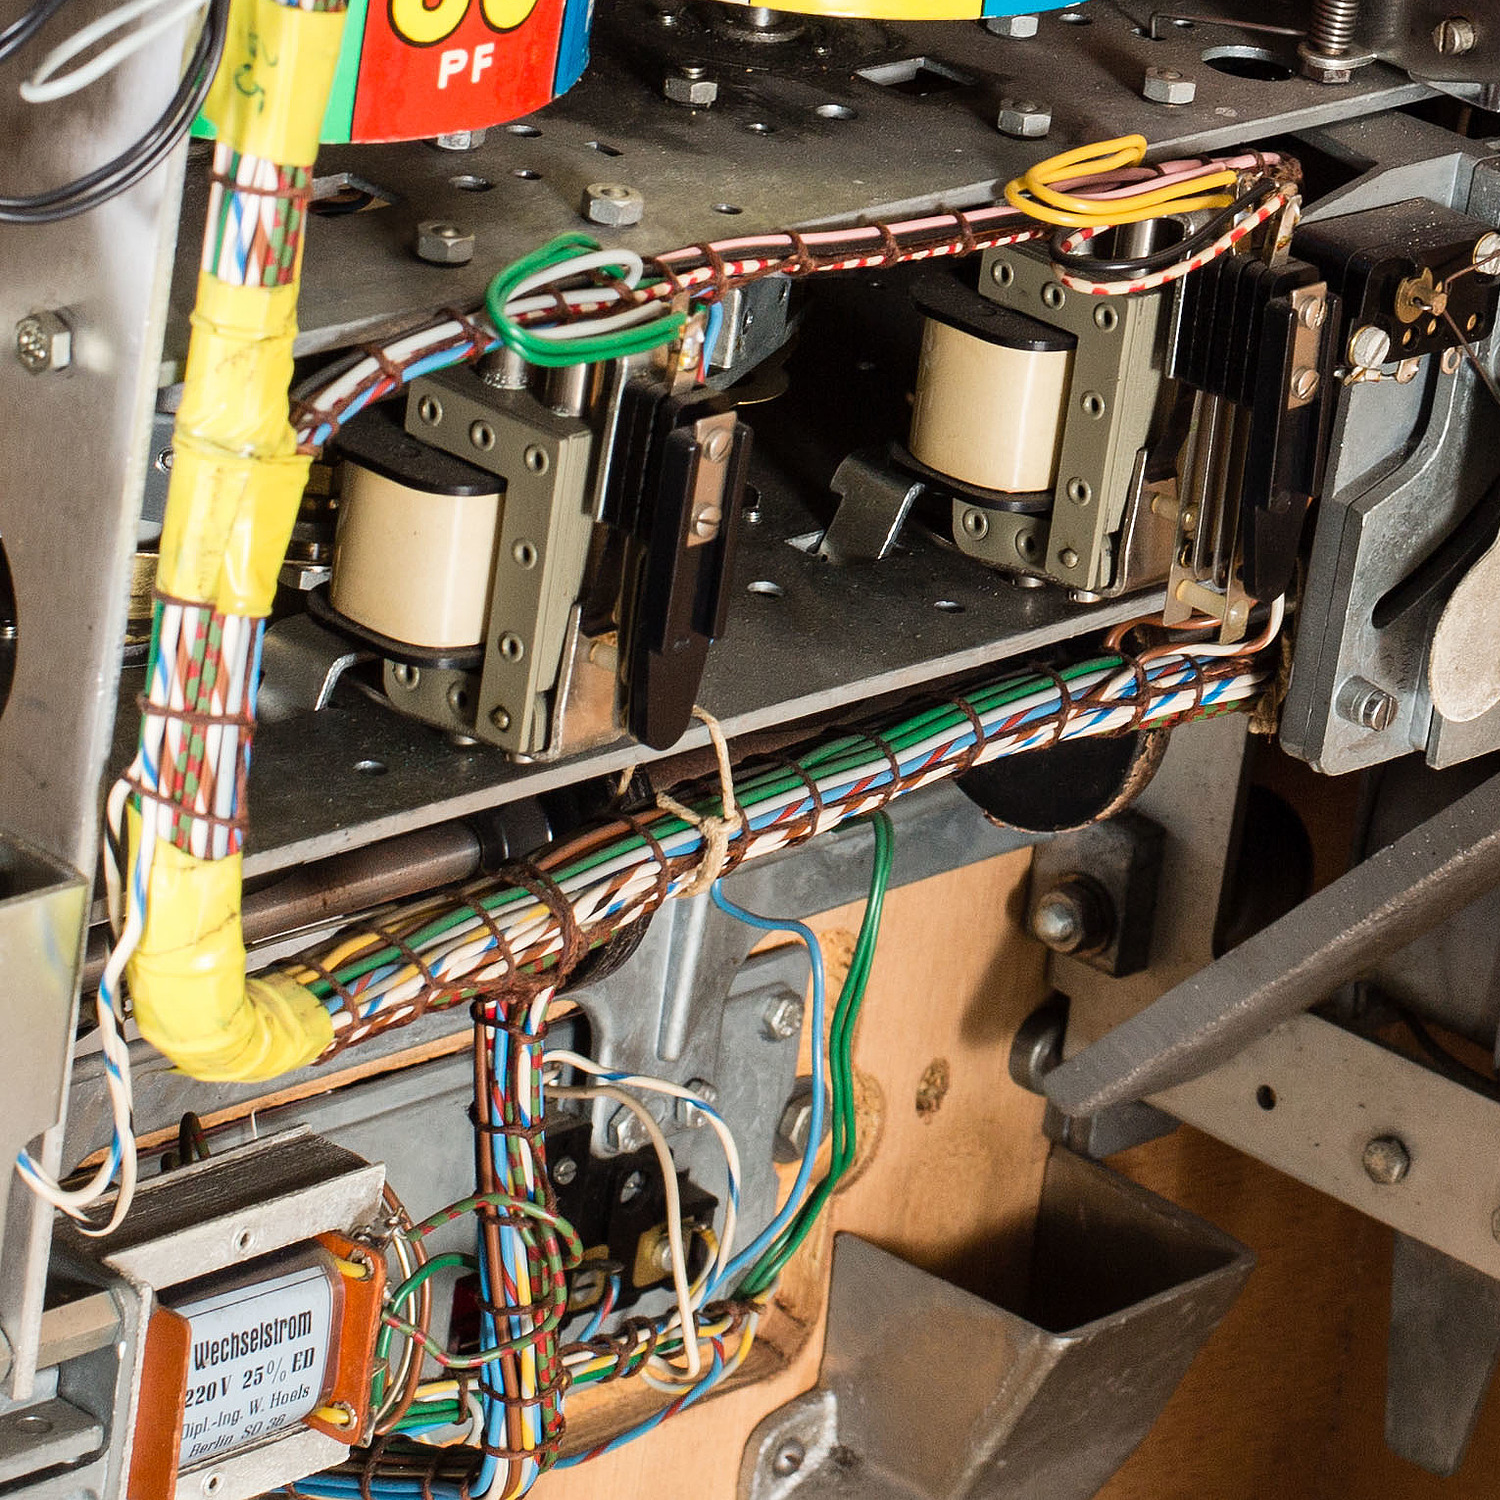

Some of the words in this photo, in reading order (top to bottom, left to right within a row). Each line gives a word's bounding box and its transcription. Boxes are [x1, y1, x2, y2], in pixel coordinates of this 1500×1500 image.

[437, 42, 495, 90] PF
[194, 1309, 313, 1372] Wechselstrom
[242, 1357, 287, 1390] 25%
[291, 1346, 316, 1373] ED
[249, 1396, 265, 1416] W.
[187, 1434, 235, 1459] Berlin
